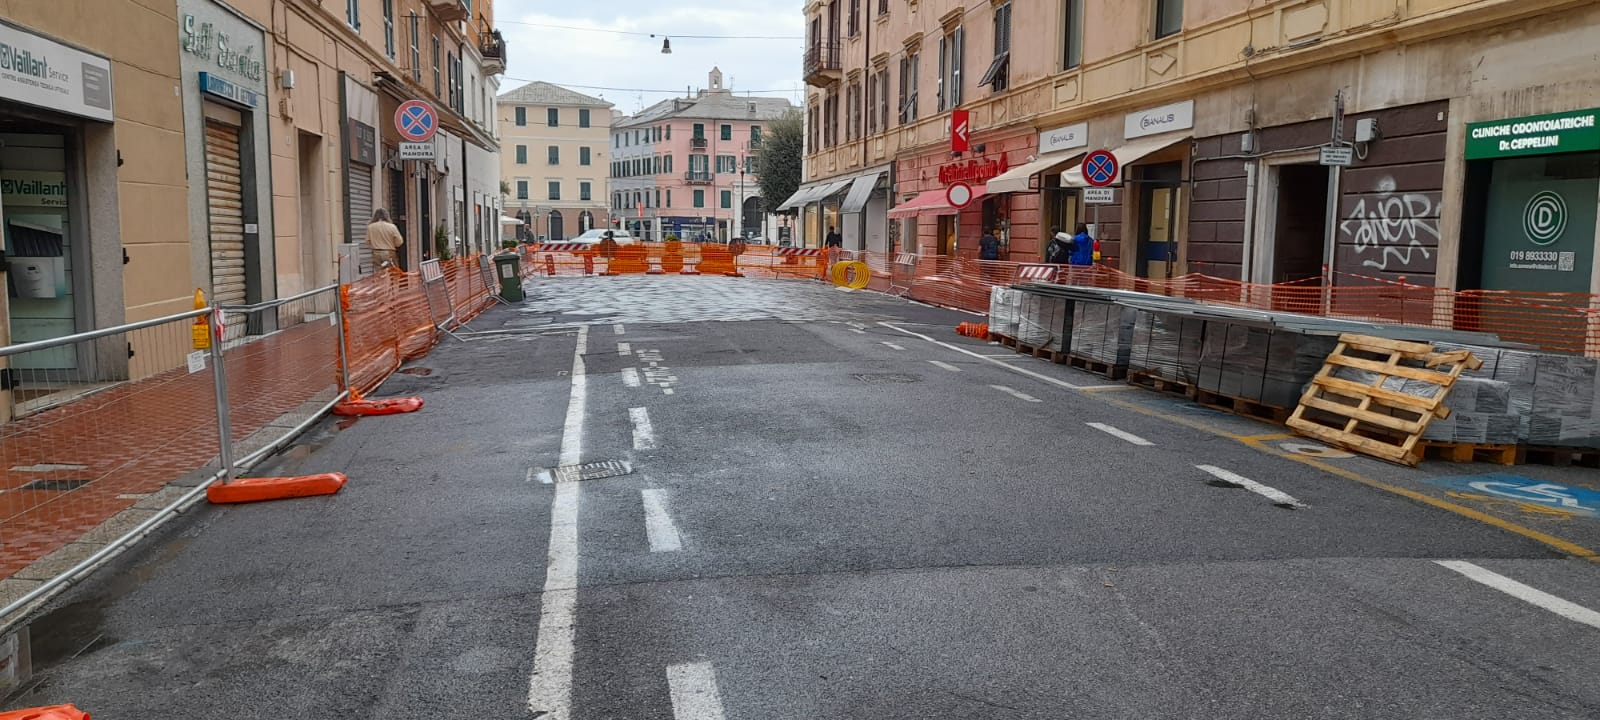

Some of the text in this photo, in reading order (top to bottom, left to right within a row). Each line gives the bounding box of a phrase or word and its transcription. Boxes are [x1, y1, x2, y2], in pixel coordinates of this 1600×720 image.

[9, 46, 48, 79] Vaillant
[1472, 115, 1595, 139] CLINICHE ODONTOIATRICHE
[1499, 135, 1559, 151] Dr. CEPPELLINI
[14, 180, 68, 195] Vaillant
[1510, 250, 1558, 262] 019 8933330
